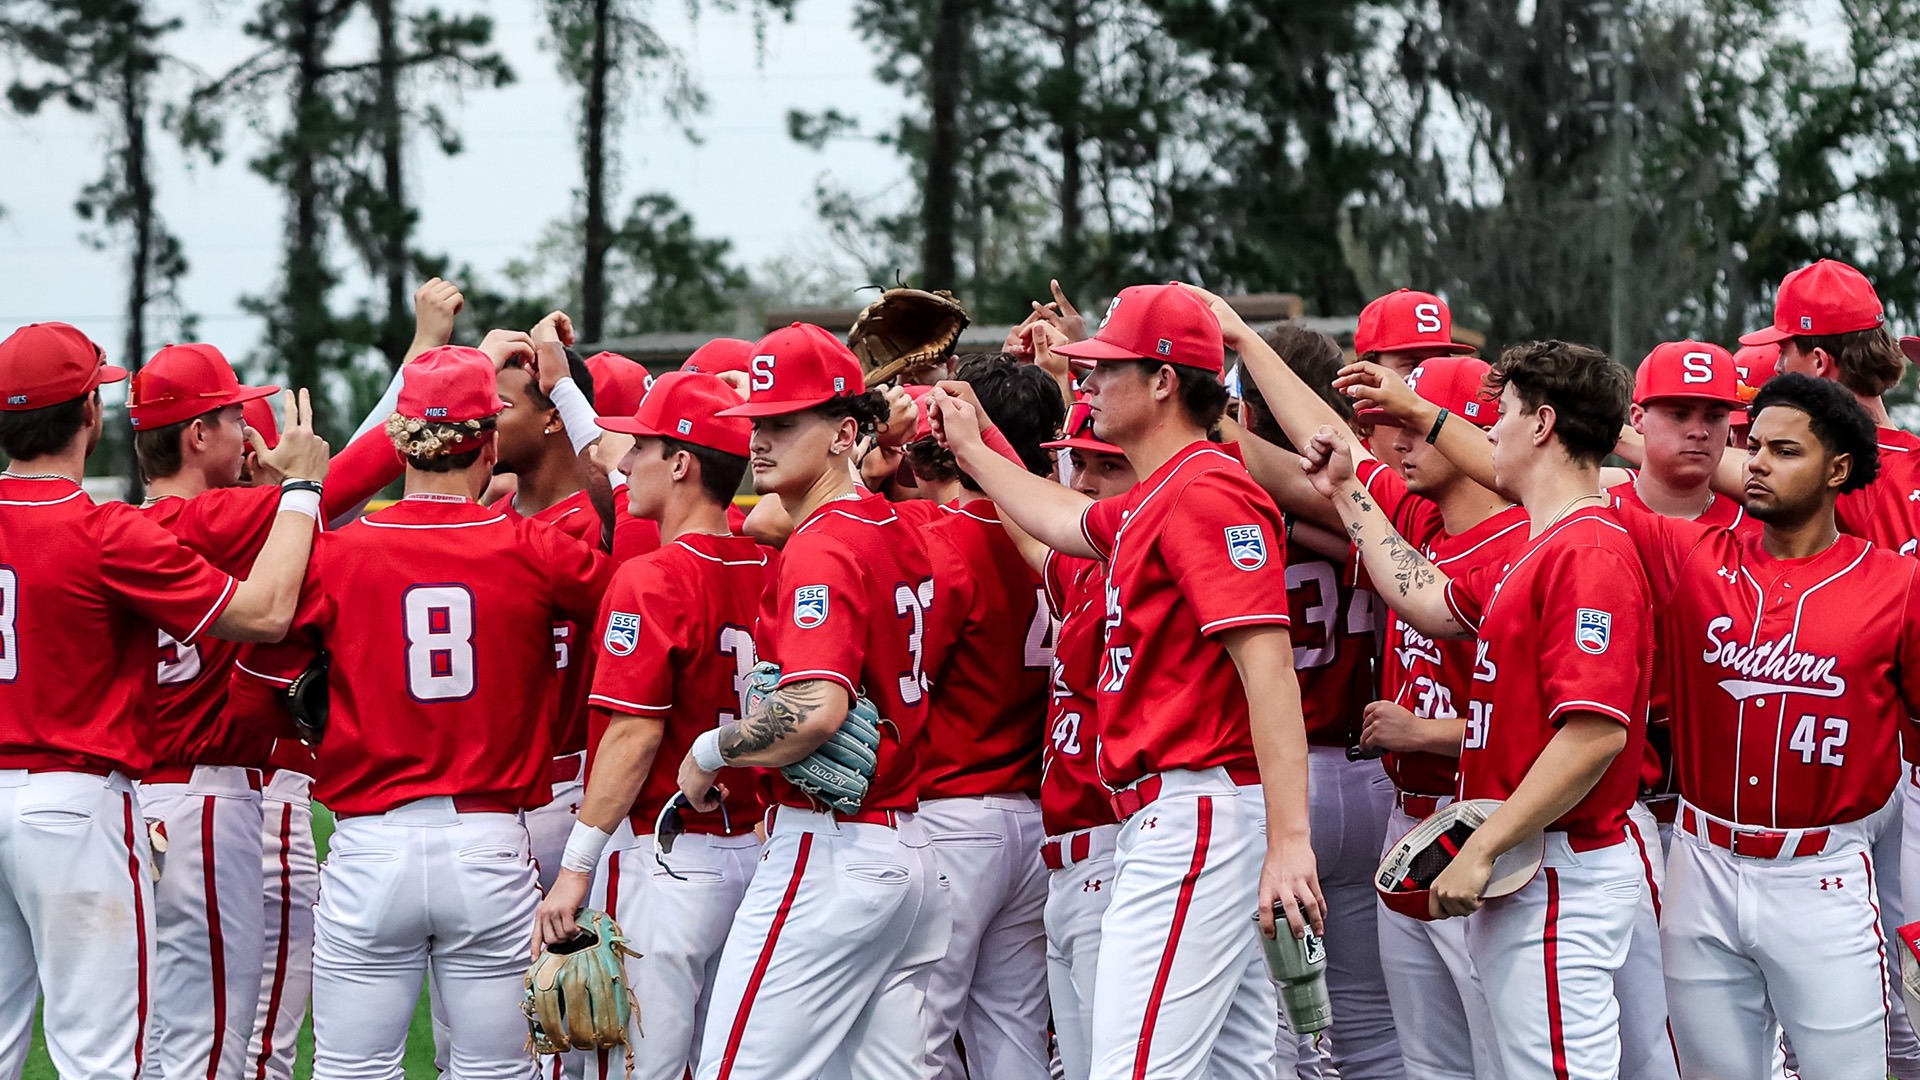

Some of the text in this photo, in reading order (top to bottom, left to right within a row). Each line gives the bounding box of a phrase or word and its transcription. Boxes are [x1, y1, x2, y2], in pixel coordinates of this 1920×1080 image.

[1414, 302, 1442, 334] S
[751, 353, 776, 392] S
[1682, 351, 1714, 384] S
[424, 406, 448, 417] MOCS
[1230, 528, 1259, 541] SSC
[798, 588, 825, 601] SSC
[613, 616, 638, 628] SSC
[1580, 612, 1608, 626] SSC
[402, 582, 478, 703] 8
[1702, 615, 1846, 700] Southern
[1788, 714, 1849, 767] 42
[809, 764, 848, 786] A2000
